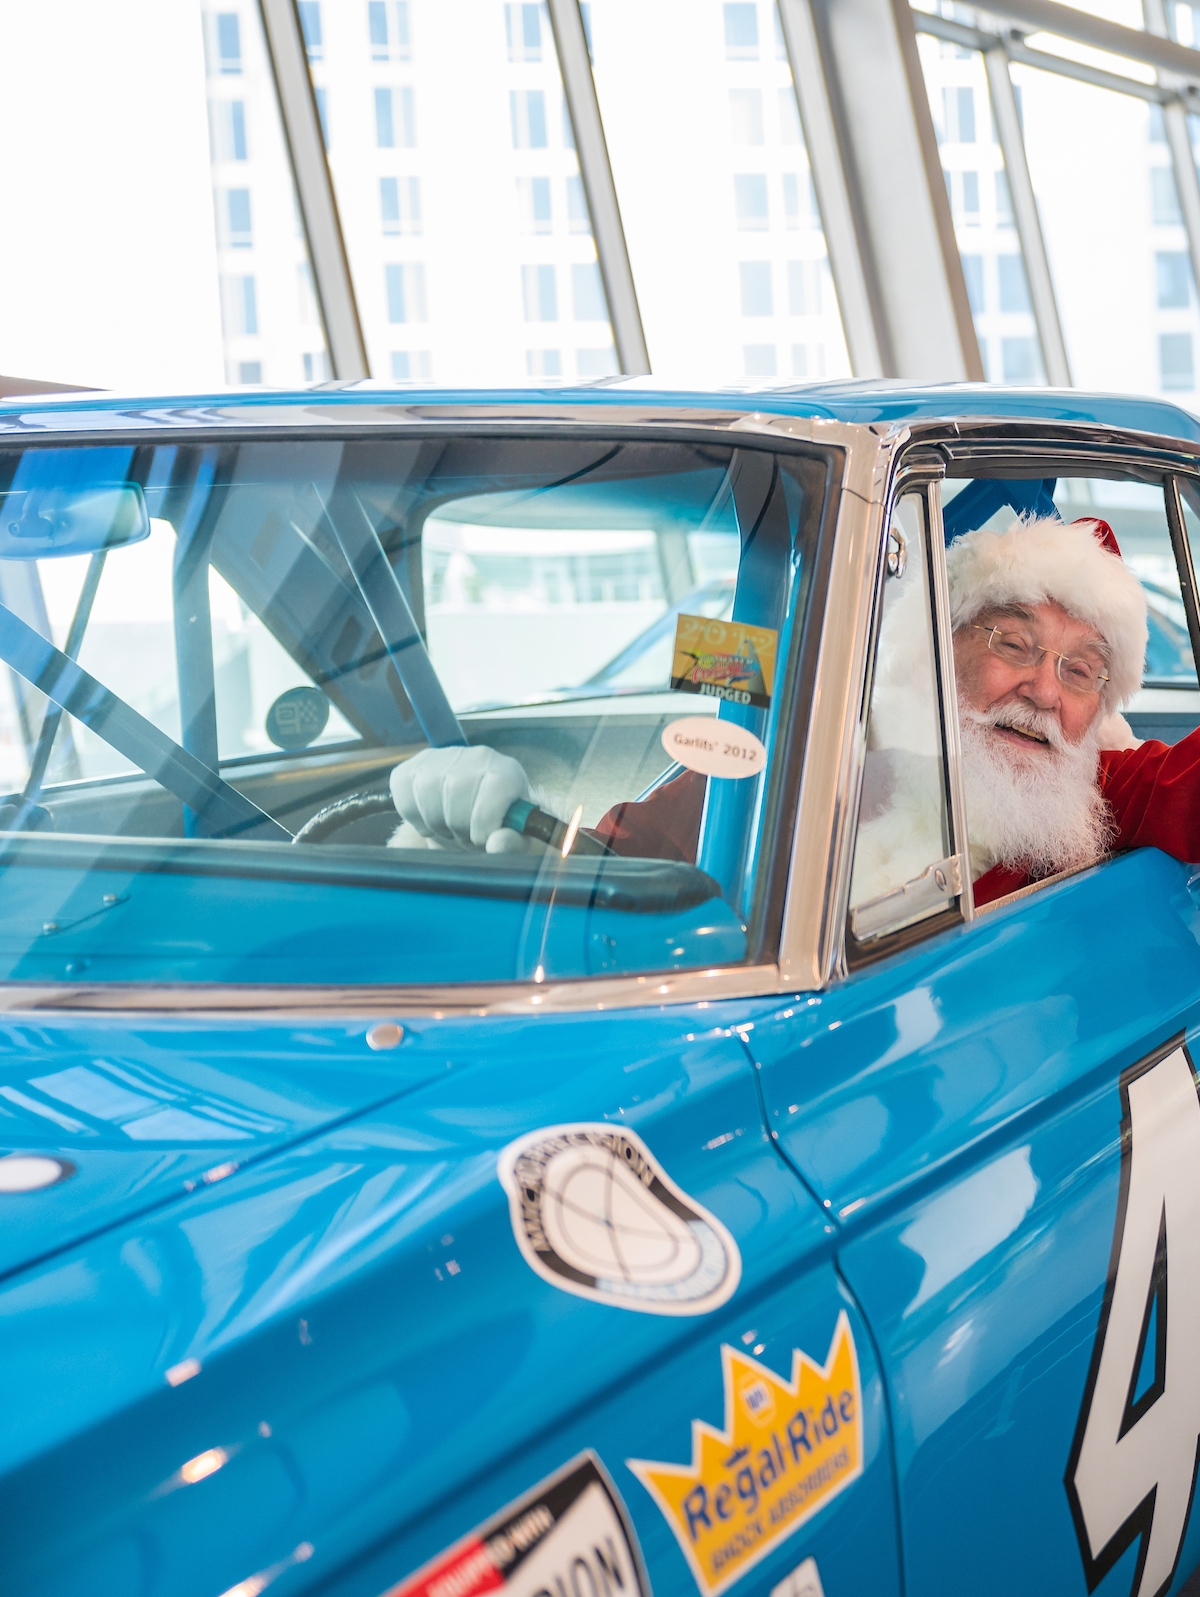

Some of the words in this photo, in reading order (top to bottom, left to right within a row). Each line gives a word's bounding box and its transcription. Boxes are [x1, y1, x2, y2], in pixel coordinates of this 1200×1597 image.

[700, 682, 751, 705] JUDGED
[673, 731, 718, 752] Garlits'
[723, 743, 757, 762] 2012
[683, 1431, 787, 1543] Regal
[786, 1388, 856, 1464] Ride
